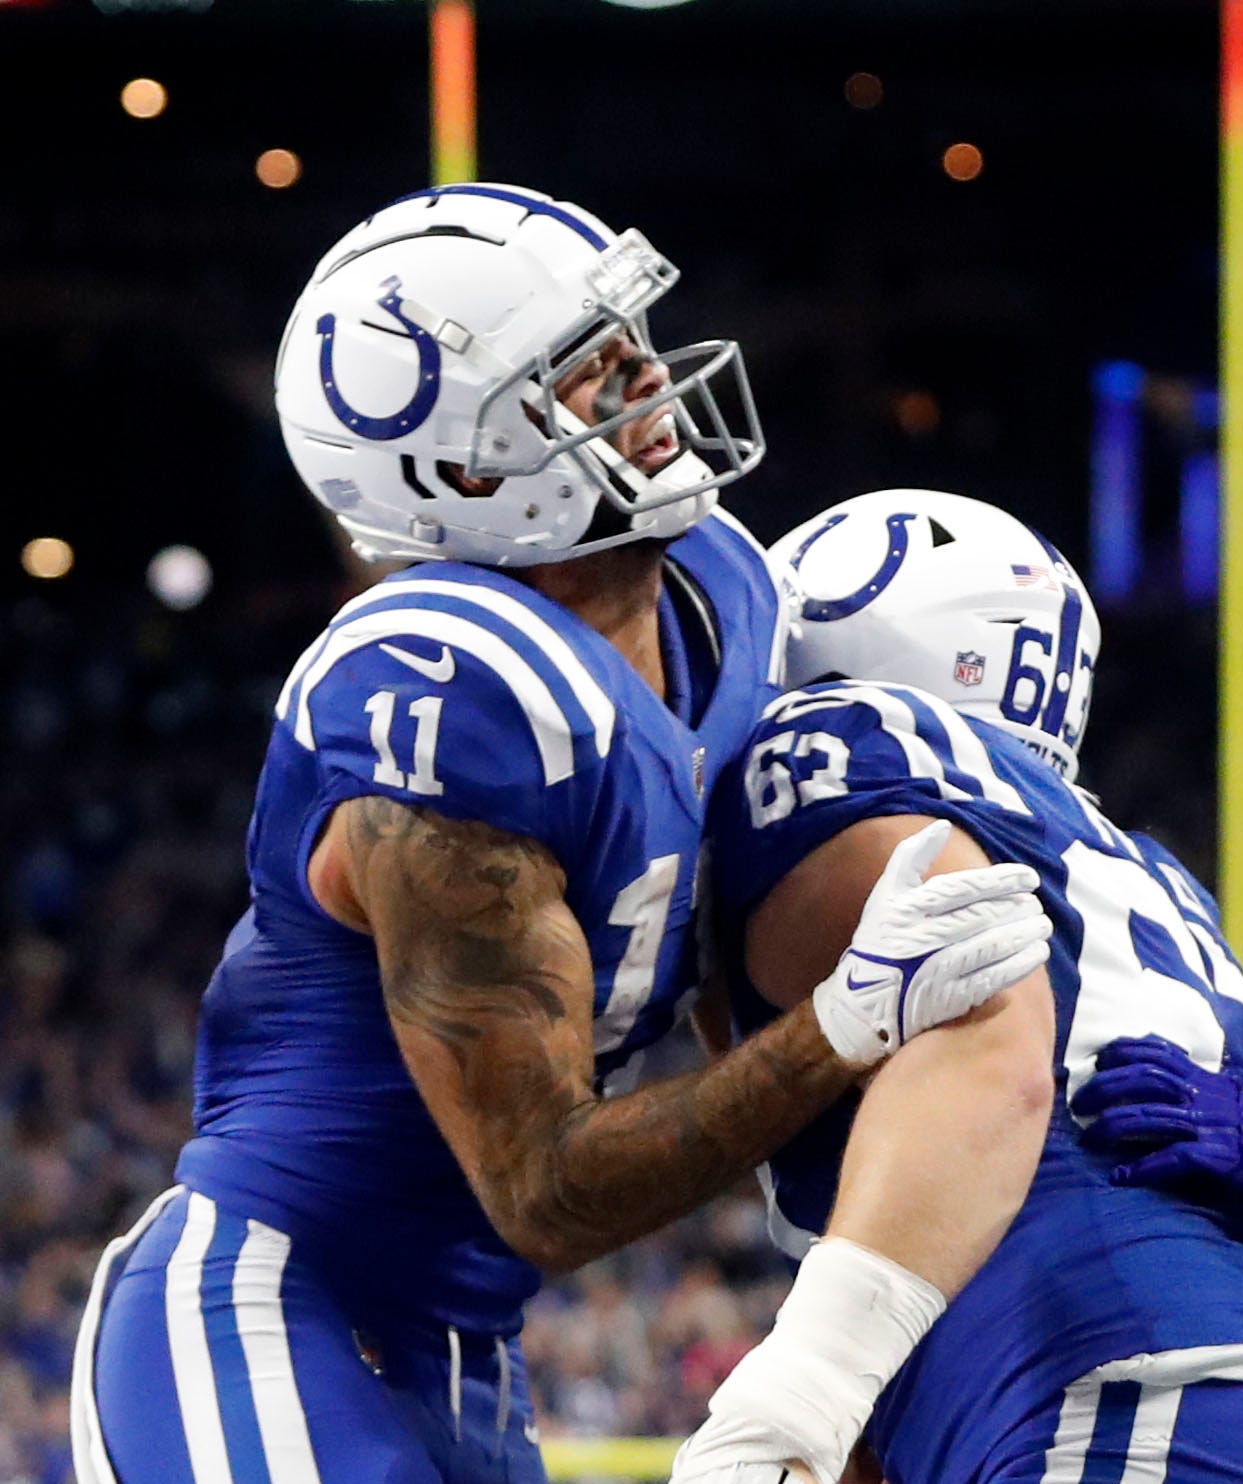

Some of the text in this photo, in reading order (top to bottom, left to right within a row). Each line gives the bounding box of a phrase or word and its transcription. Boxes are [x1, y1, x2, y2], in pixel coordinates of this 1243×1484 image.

[957, 664, 983, 684] NFL
[364, 690, 444, 796] 11
[744, 730, 851, 830] 63
